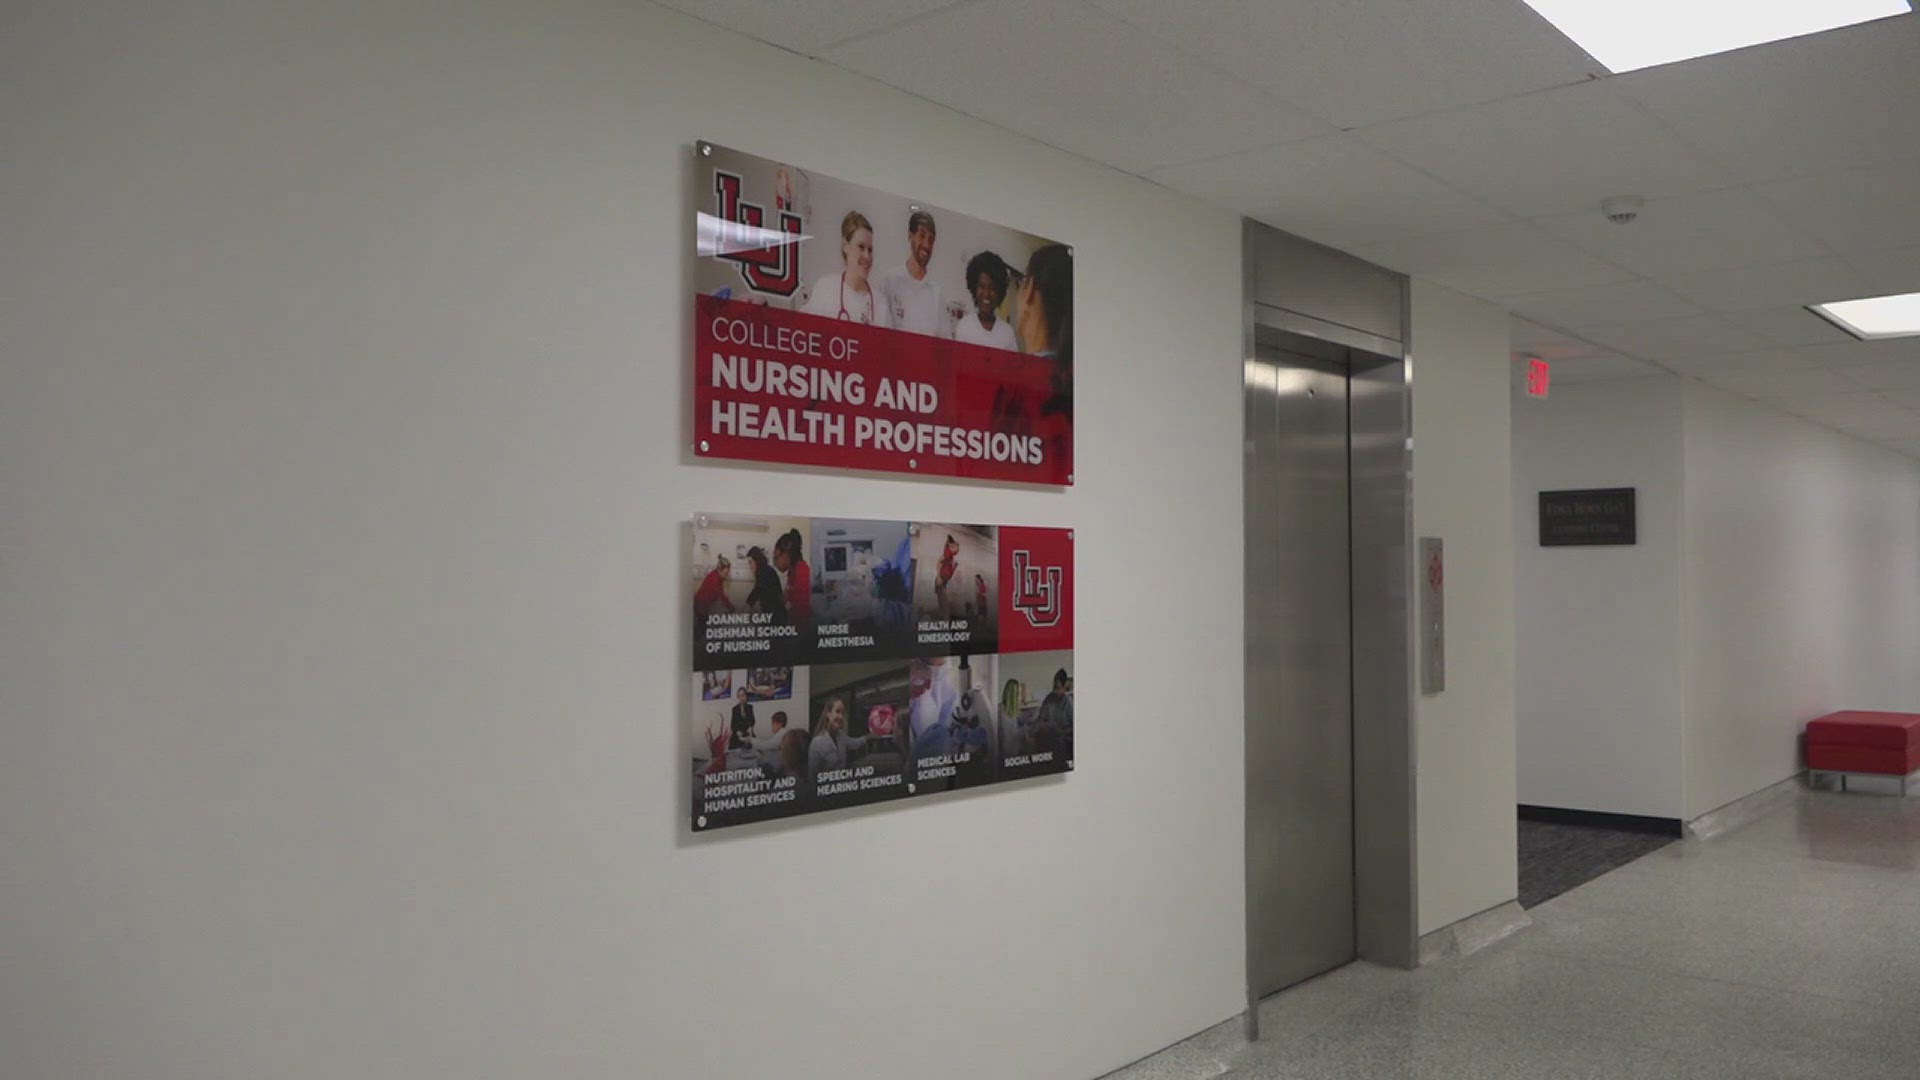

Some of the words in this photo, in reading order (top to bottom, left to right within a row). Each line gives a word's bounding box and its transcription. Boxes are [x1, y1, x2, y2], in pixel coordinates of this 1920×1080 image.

[712, 316, 822, 357] COLLEGE
[829, 336, 860, 361] OF
[712, 353, 866, 406] NURSING
[874, 377, 939, 414] AND
[711, 400, 845, 446] HEALTH
[855, 416, 1043, 465] PROFESSIONS
[706, 613, 750, 625] JOANNE
[751, 612, 773, 624] GAY
[918, 621, 949, 631] HEALTH
[950, 620, 968, 630] AND
[706, 627, 755, 639] DISHMAN
[757, 626, 798, 637] SCHOOL
[817, 624, 849, 635] NURSE
[917, 632, 971, 643] KINESIOLOGY
[706, 642, 721, 653] OF
[723, 640, 771, 653] NURSING
[817, 636, 875, 648] ANESTHESIA
[917, 754, 953, 768] MEDICAL
[954, 752, 970, 764] LAB
[1004, 755, 1031, 767] SOCIAL
[1031, 751, 1053, 763] WORK
[704, 767, 765, 784] NUTRITION,
[817, 770, 853, 783] SPEECH
[854, 766, 874, 778] AND
[917, 766, 956, 781] SCIENCES
[704, 780, 772, 798] HOSPITALITY
[773, 776, 796, 789] AND
[817, 782, 859, 796] HEARING
[860, 774, 902, 790] SCIENCES
[704, 797, 745, 813] HUMAN
[747, 790, 795, 807] SERVICES
